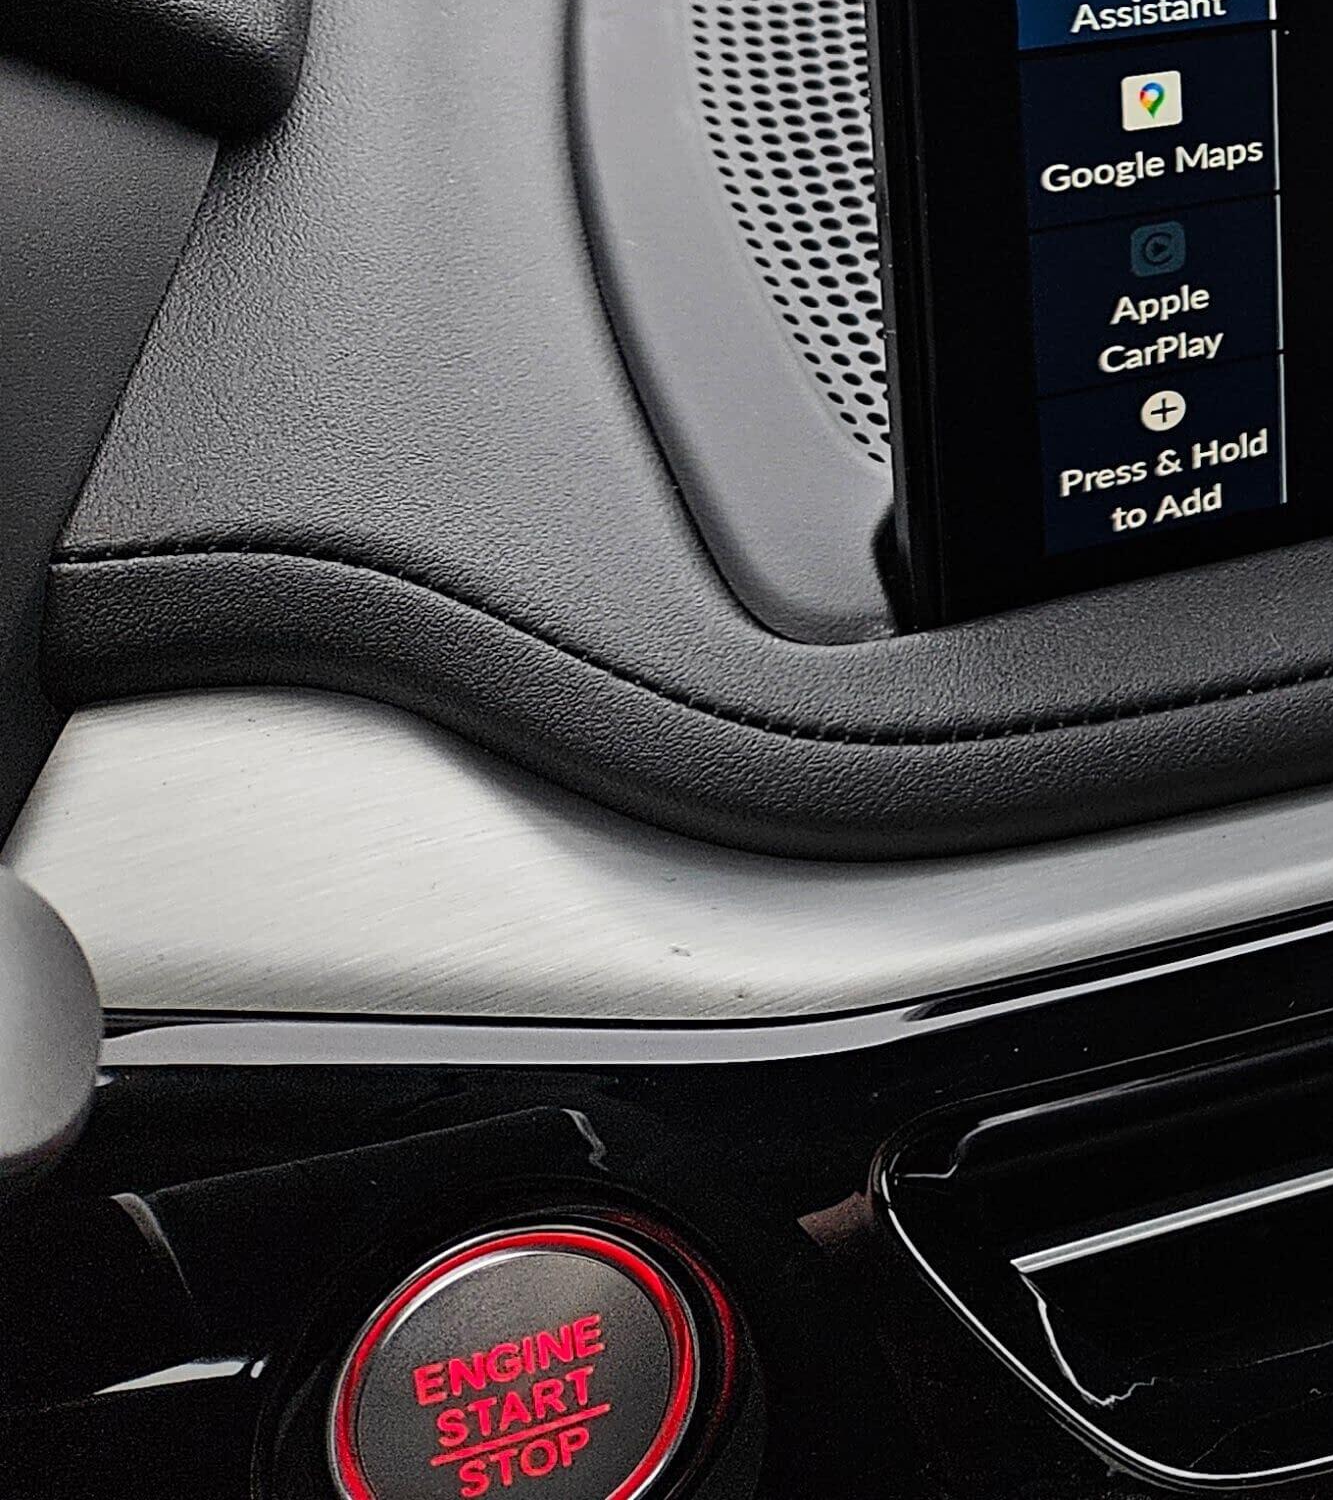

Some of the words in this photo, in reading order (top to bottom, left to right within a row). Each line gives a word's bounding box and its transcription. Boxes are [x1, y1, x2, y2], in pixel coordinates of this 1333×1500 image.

[1041, 150, 1165, 192] Google
[1175, 141, 1264, 173] Maps
[1110, 284, 1210, 325] Apple
[1099, 331, 1224, 373] CarPlay
[1060, 461, 1148, 497] Press
[1155, 449, 1183, 477] &
[1191, 427, 1268, 470] Hold
[1111, 507, 1148, 532] to
[1153, 482, 1222, 523] Add
[413, 1314, 605, 1405] ENGINE
[437, 1366, 594, 1446] START
[459, 1427, 590, 1498] STOP
